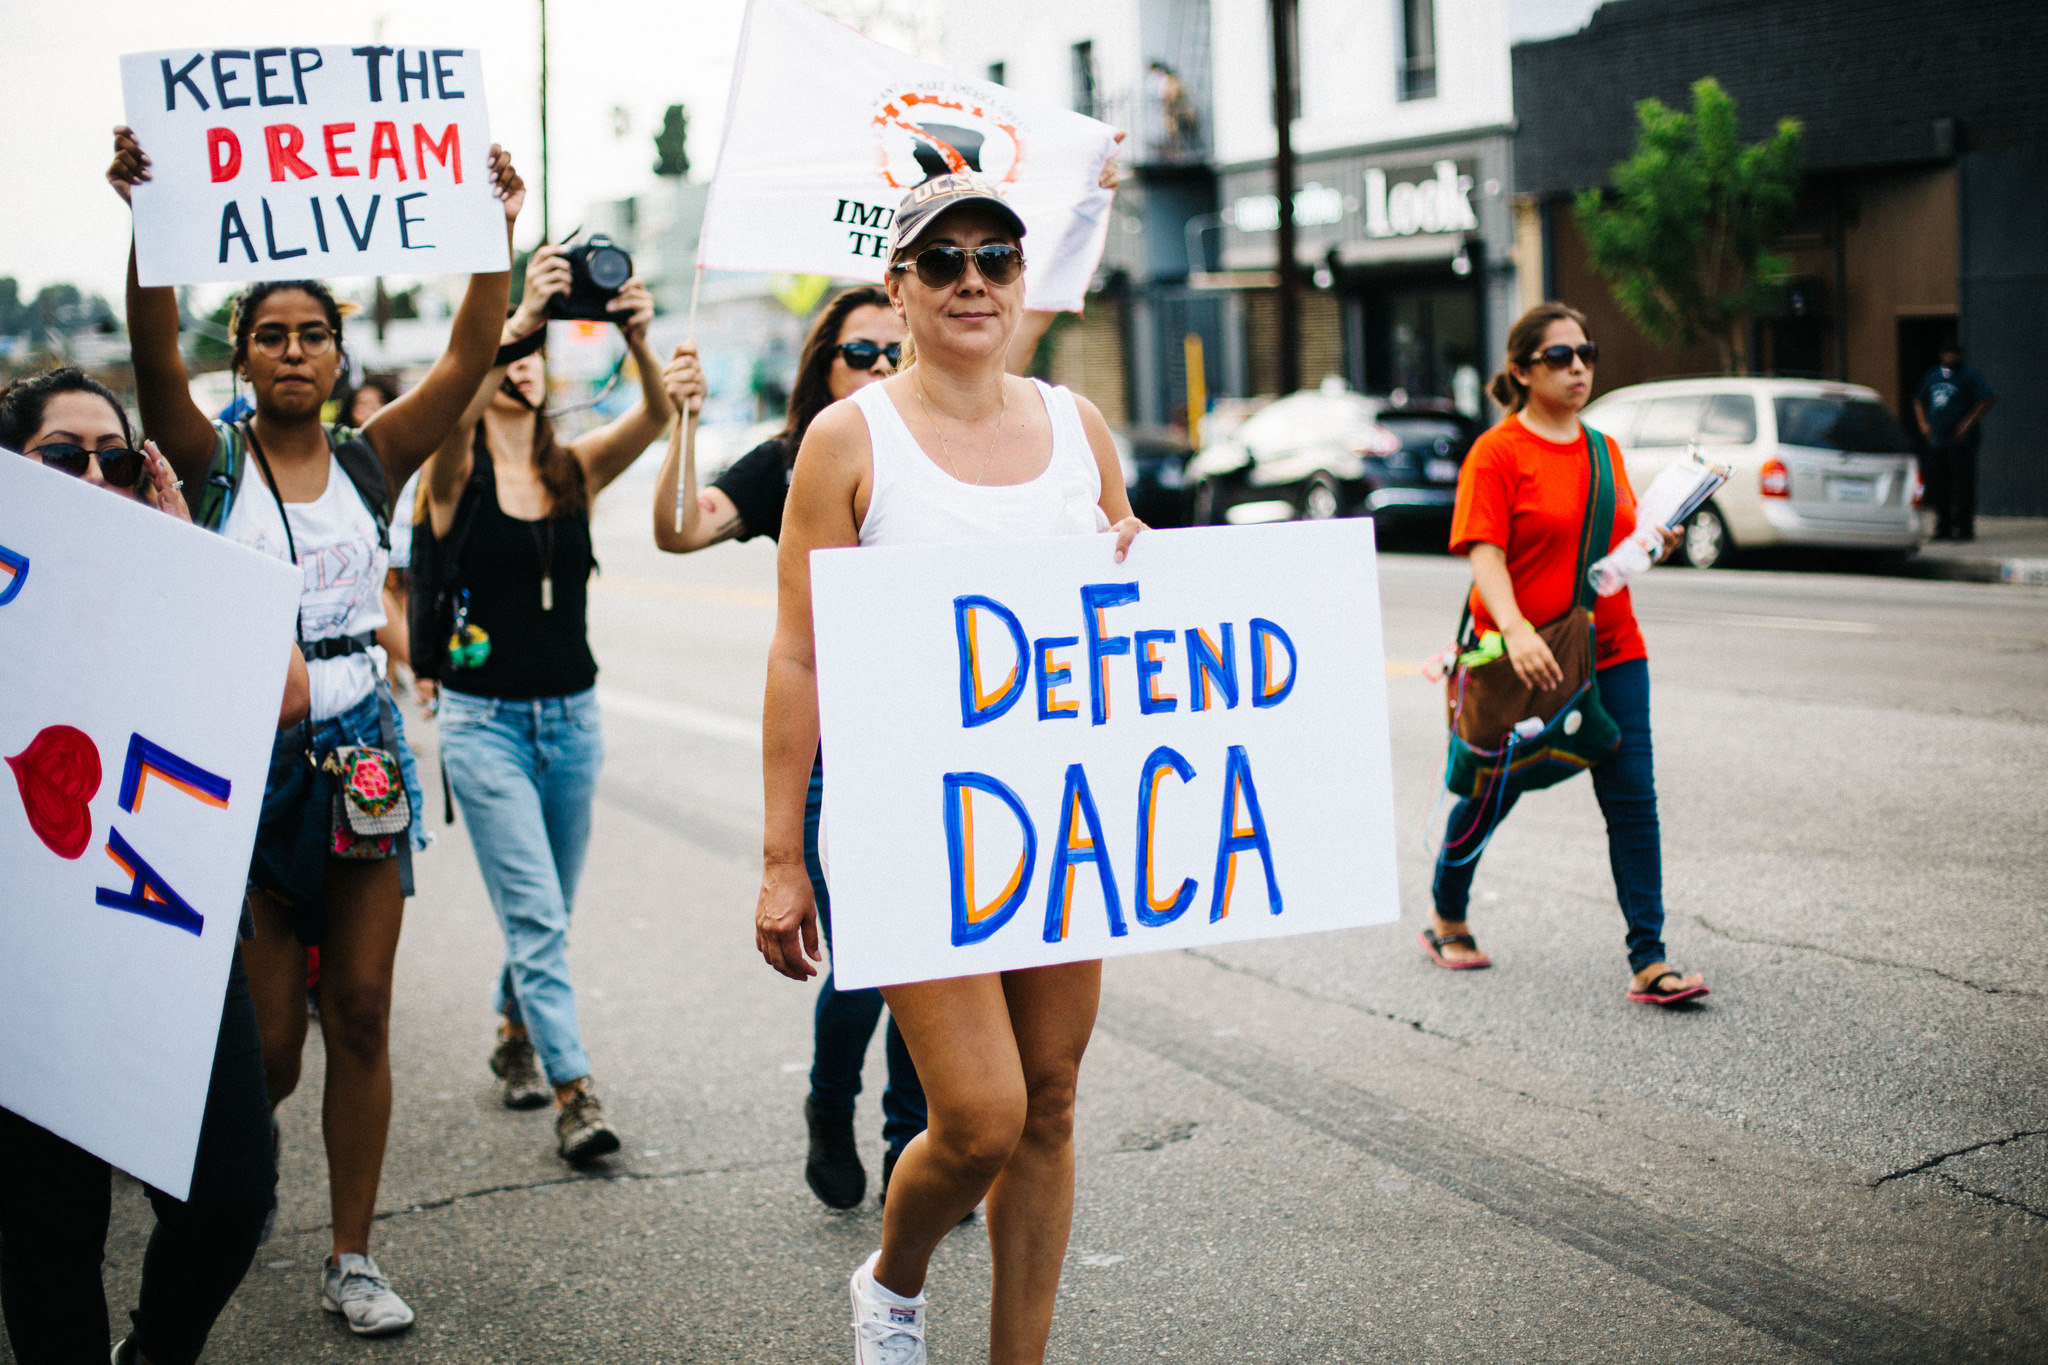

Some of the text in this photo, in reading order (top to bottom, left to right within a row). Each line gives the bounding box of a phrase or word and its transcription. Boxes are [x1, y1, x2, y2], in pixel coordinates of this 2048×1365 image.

[160, 45, 465, 112] KEEP THE
[206, 120, 463, 185] DREAM
[218, 191, 436, 264] ALIVE
[942, 744, 1284, 947] DACA
